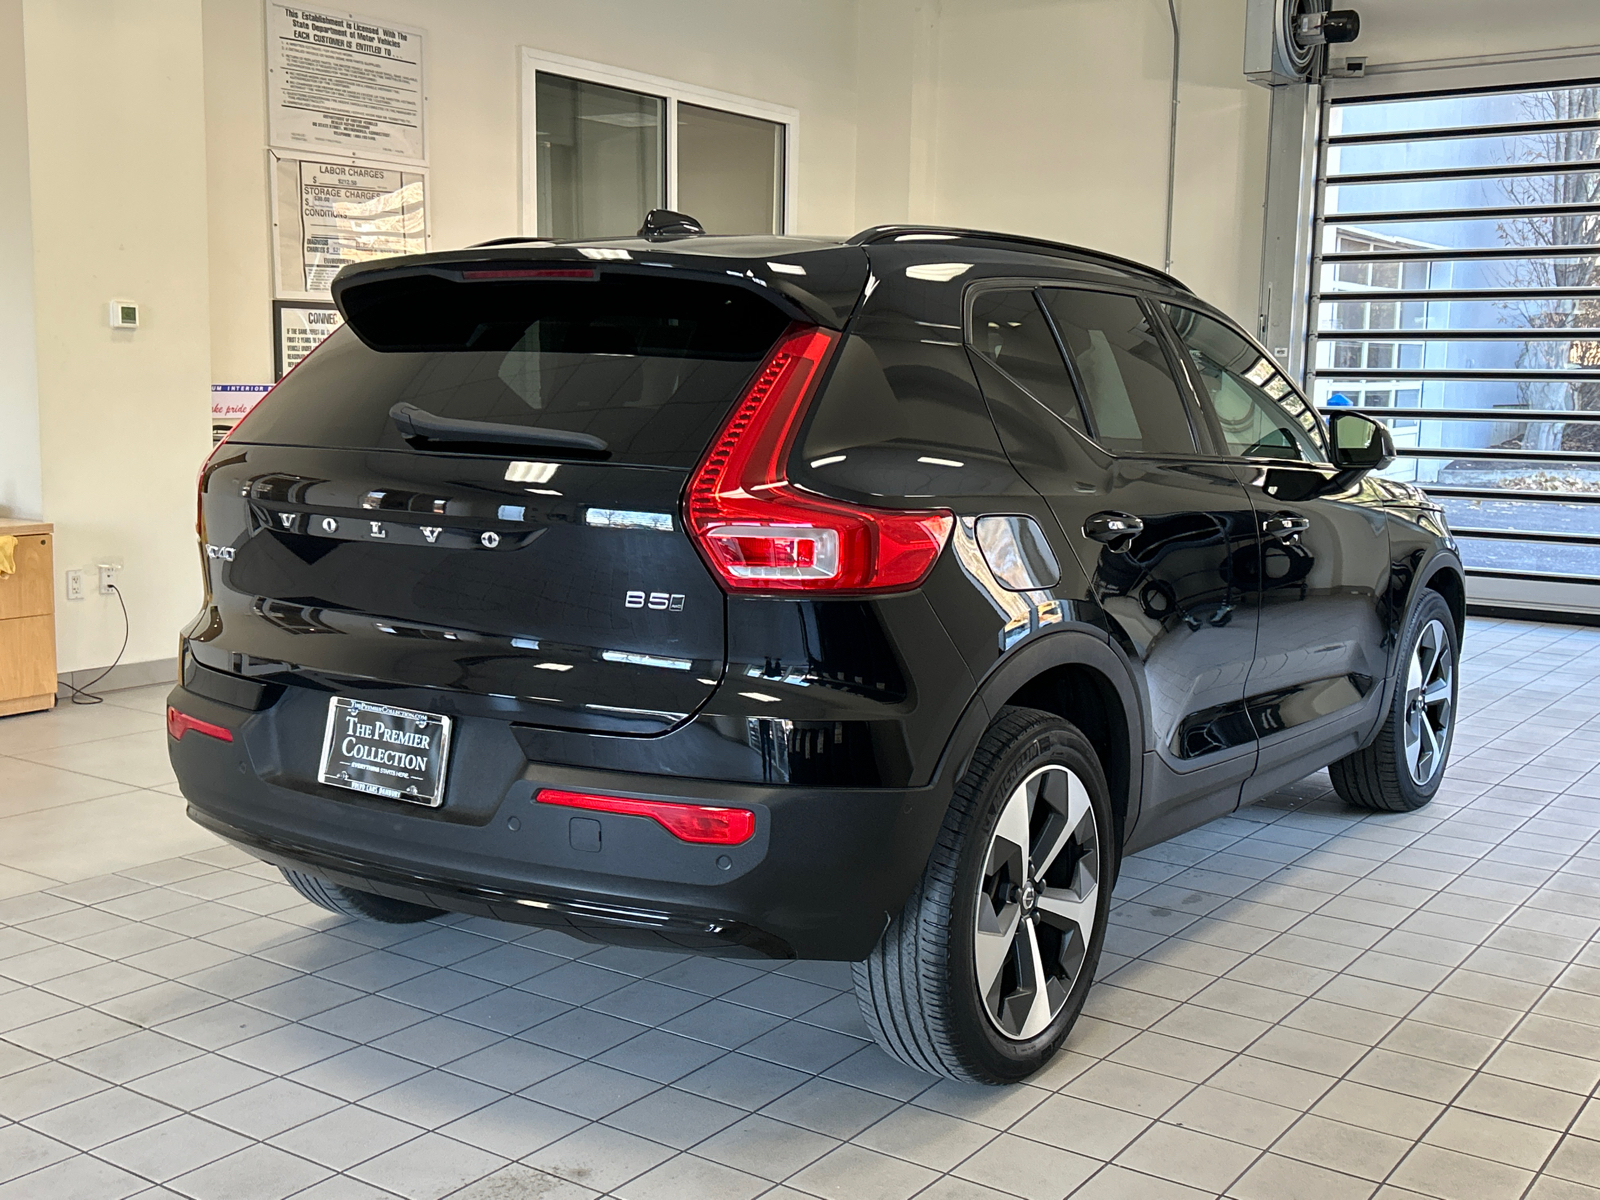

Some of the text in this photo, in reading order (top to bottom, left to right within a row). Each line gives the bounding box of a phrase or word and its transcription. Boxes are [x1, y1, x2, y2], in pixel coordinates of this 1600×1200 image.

[285, 8, 298, 18] This
[302, 12, 344, 28] Establishment
[354, 23, 379, 35] Licensed
[383, 29, 396, 38] With
[398, 32, 408, 42] The
[292, 20, 400, 48] State Department of Motor Vehicles
[294, 30, 310, 40] EACH
[314, 34, 344, 48] CUSTOMER
[346, 40, 352, 48] IS
[356, 42, 382, 54] ENTITLED
[384, 48, 392, 56] TO
[312, 176, 317, 184] $
[320, 166, 384, 180] LABOR CHARGES
[304, 187, 342, 198] STORAGE
[304, 198, 310, 206] $
[225, 404, 247, 416] pride
[278, 512, 500, 548] VOLVO
[625, 590, 670, 610] B5
